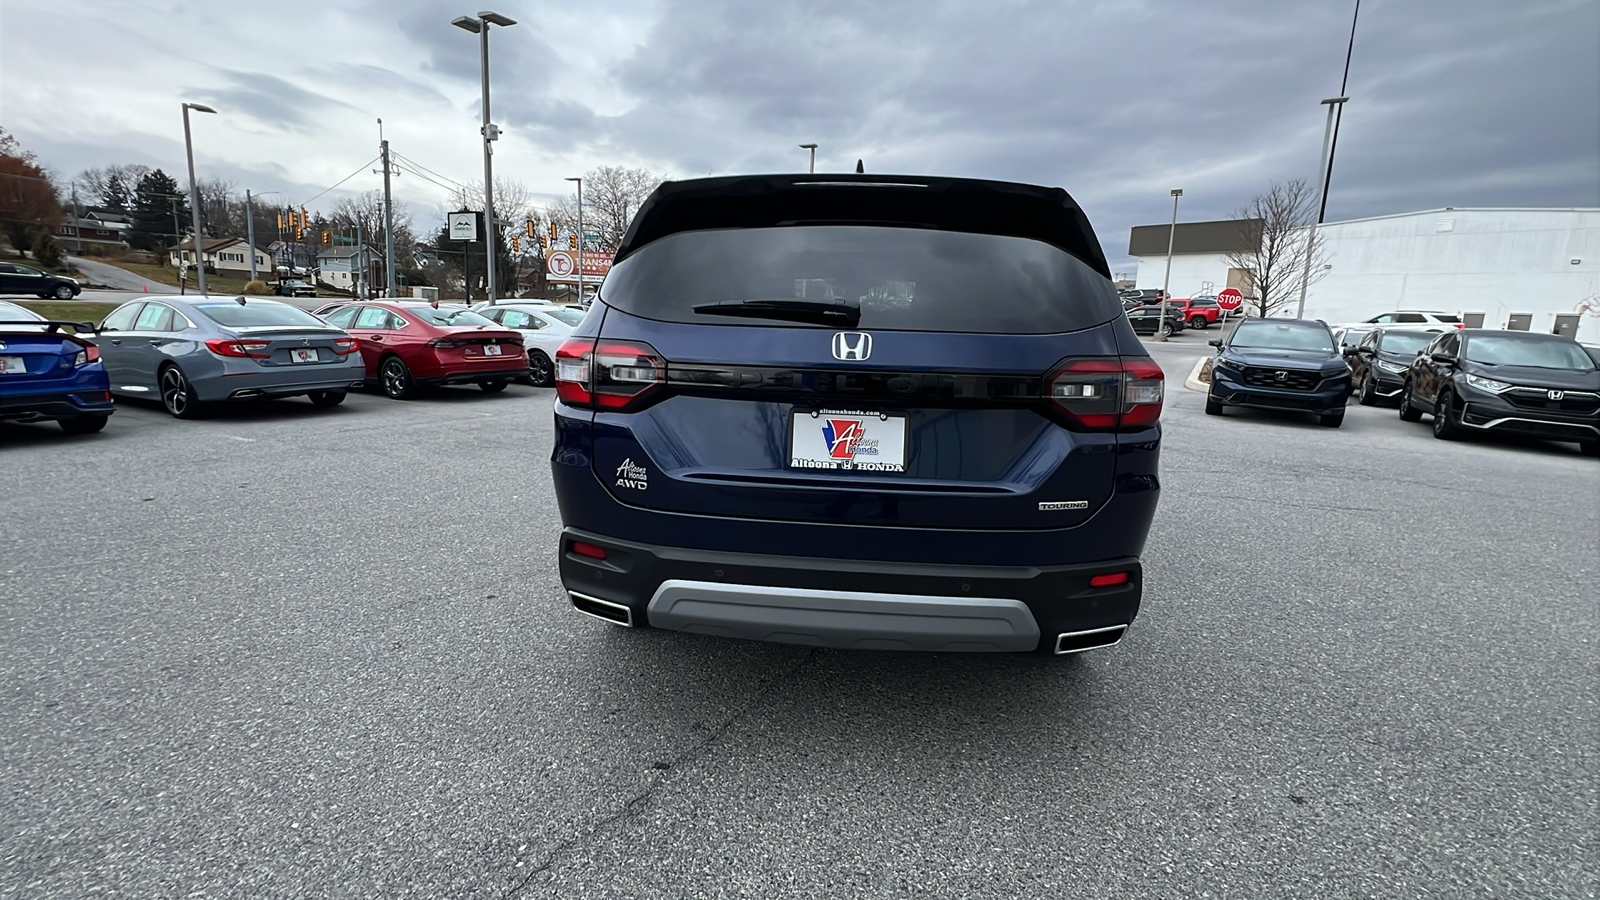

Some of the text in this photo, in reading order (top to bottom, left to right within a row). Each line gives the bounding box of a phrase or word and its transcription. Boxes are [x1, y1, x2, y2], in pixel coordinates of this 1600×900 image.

[1218, 294, 1242, 304] STOP
[733, 372, 970, 397] PILOT
[819, 408, 880, 416] altoonahonda.com
[849, 445, 878, 454] Honda
[791, 459, 904, 472] Altoona HONDA
[628, 472, 647, 480] Honda
[615, 478, 648, 490] AWD
